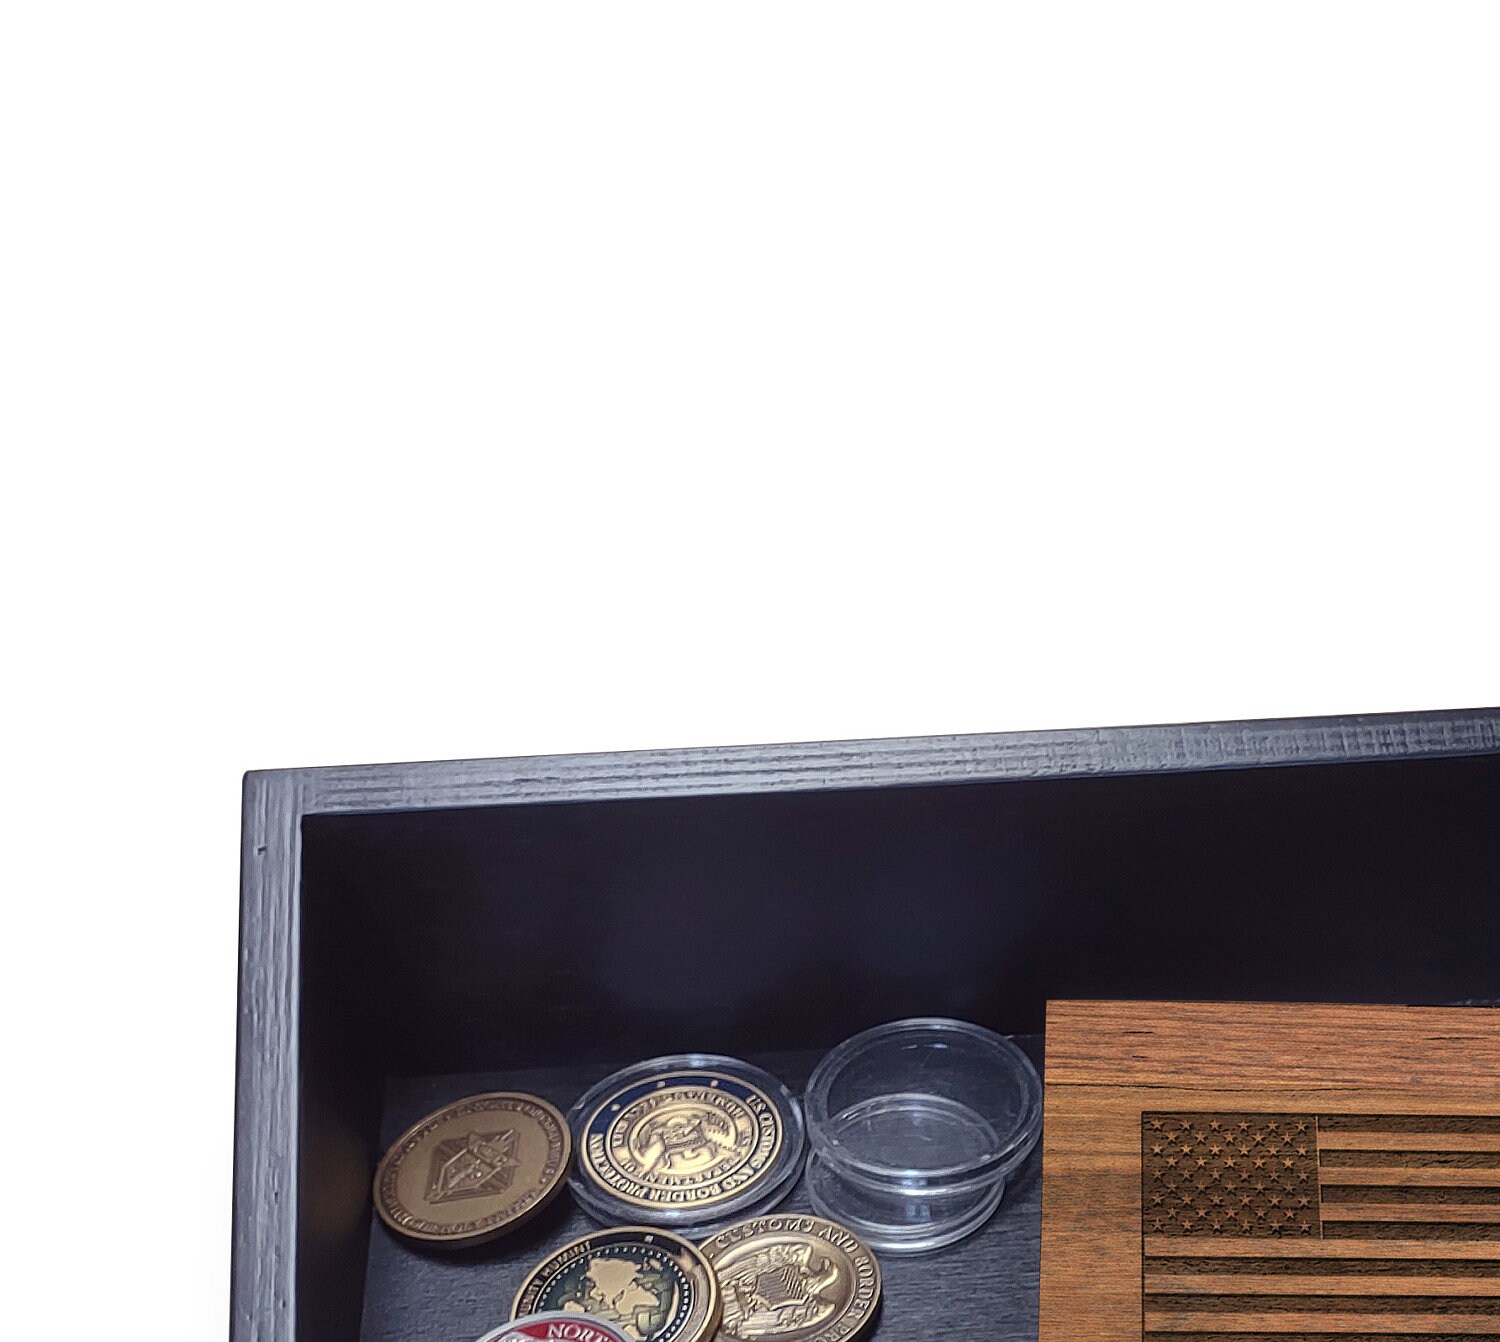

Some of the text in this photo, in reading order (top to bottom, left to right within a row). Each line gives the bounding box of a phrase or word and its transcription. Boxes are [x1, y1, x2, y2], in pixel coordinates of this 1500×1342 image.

[648, 1183, 723, 1203] BORDER
[723, 1165, 756, 1193] AND
[715, 1217, 815, 1249] CUSTOMS
[818, 1225, 860, 1254] AND
[847, 1255, 875, 1320] BORDER
